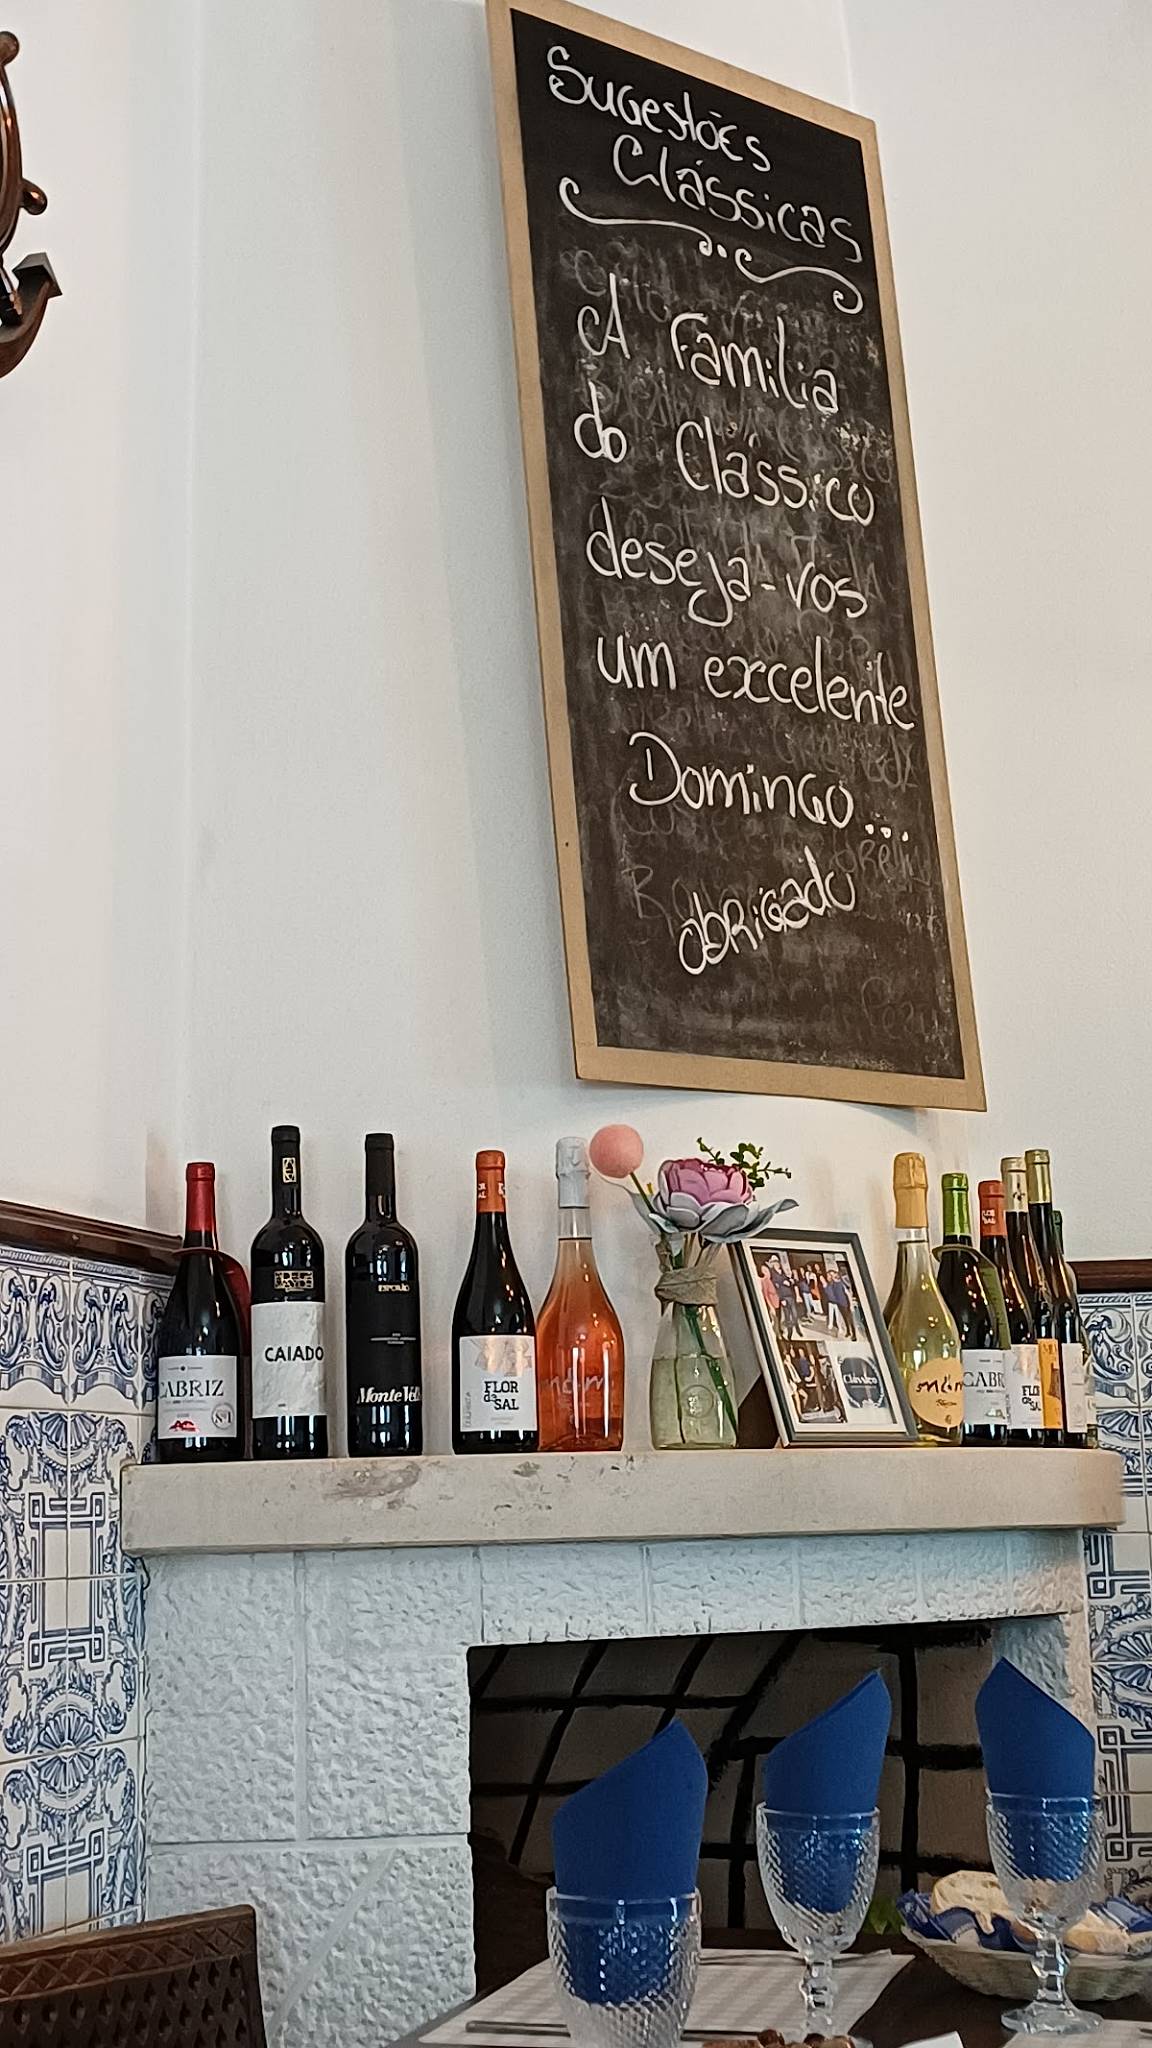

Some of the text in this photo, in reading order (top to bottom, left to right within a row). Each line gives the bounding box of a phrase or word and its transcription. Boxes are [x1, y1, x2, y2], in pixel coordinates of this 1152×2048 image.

[577, 272, 630, 359] A
[574, 380, 627, 463] do
[598, 634, 915, 730] um excelente
[265, 1345, 324, 1362] CAIADO
[356, 1386, 403, 1404] Monte
[484, 1380, 519, 1394] FLOR
[494, 1398, 520, 1411] SAL
